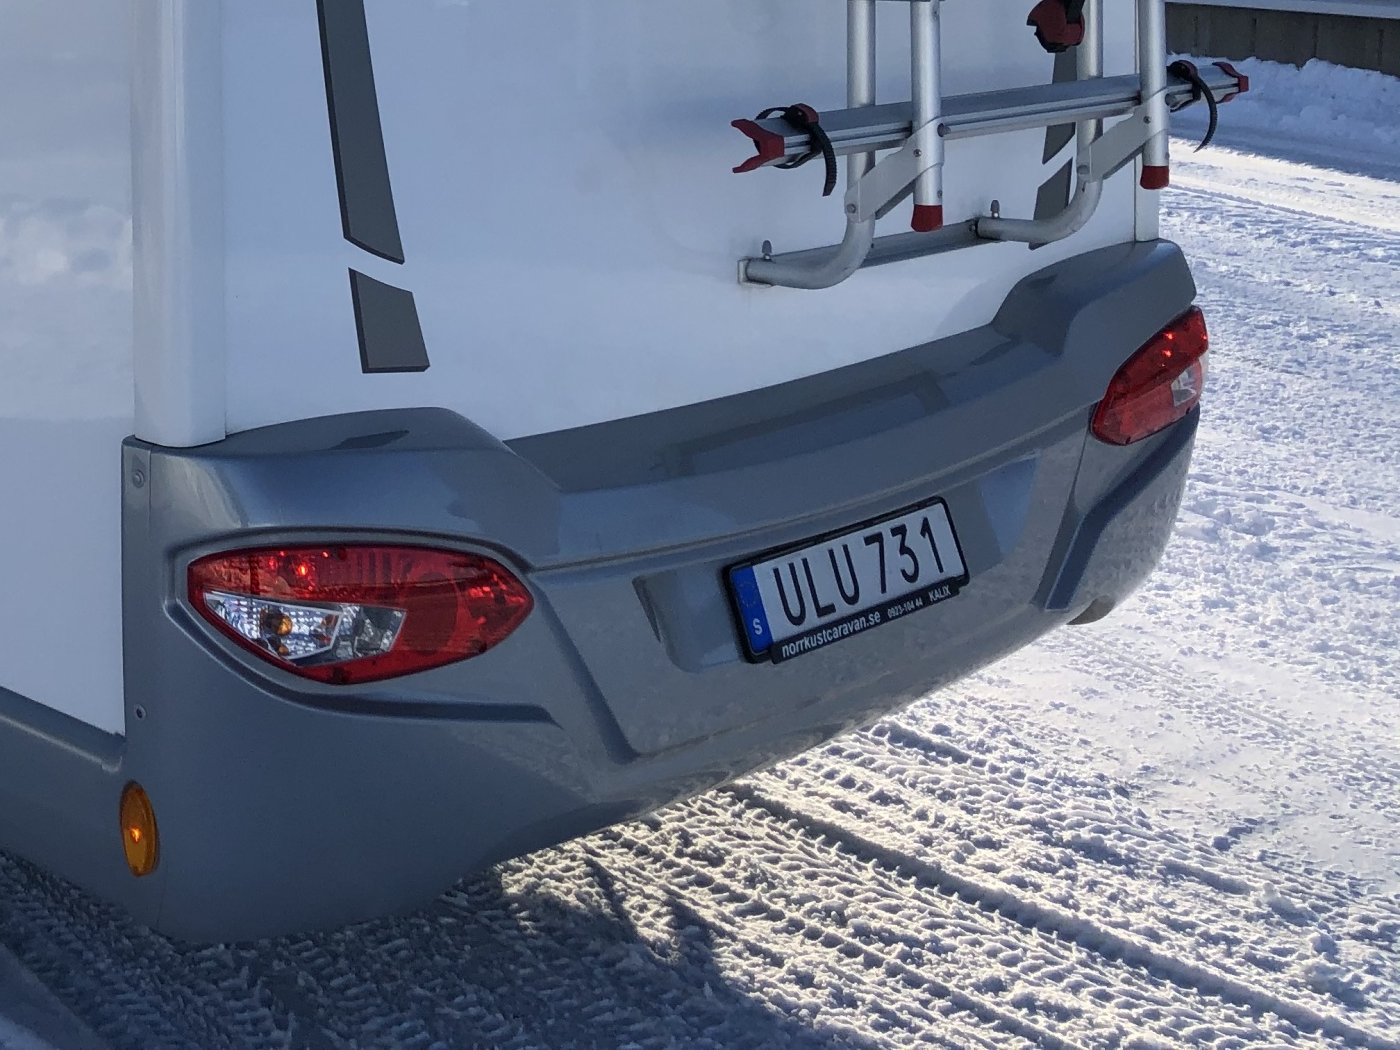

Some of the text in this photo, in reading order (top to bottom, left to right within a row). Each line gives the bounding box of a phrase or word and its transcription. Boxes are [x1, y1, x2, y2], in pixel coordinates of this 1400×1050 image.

[772, 516, 945, 626] ULU 731
[752, 617, 763, 636] S
[781, 610, 881, 658] norrkustcaravan.se
[928, 585, 952, 602] KALIX
